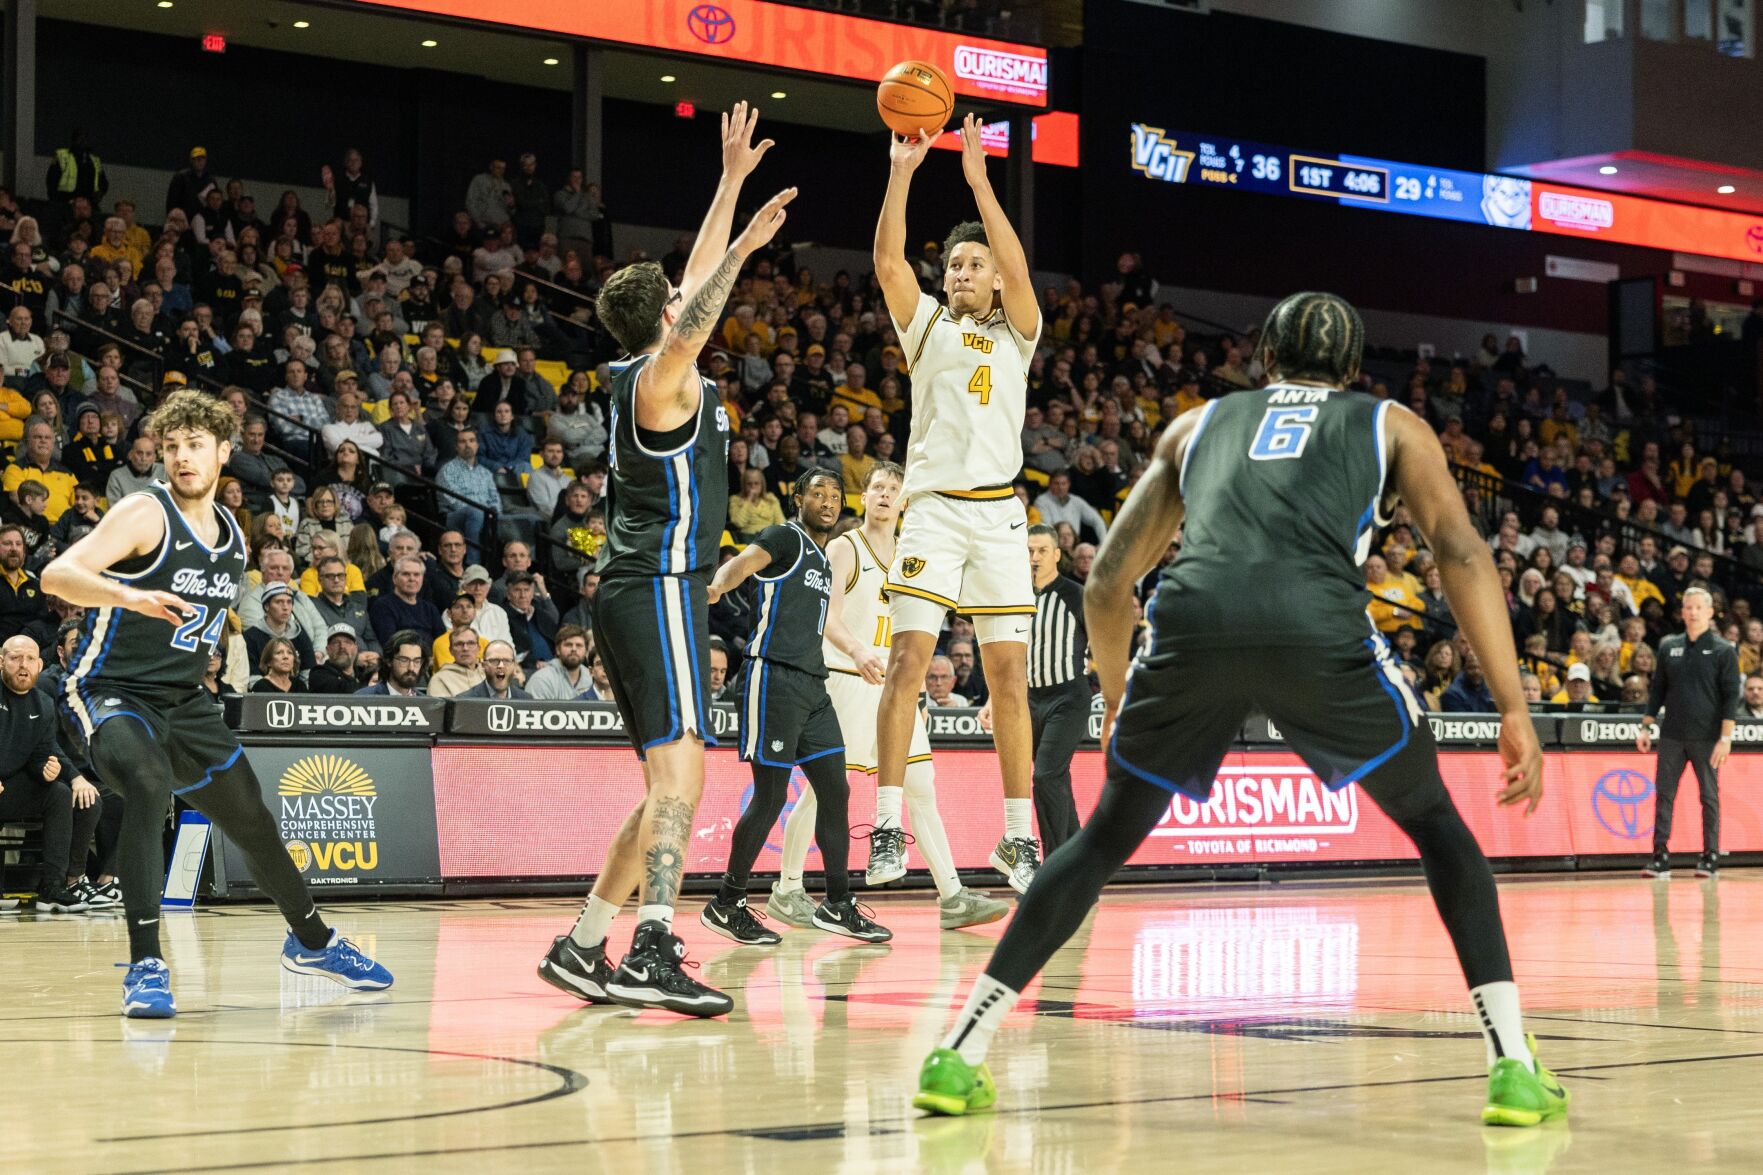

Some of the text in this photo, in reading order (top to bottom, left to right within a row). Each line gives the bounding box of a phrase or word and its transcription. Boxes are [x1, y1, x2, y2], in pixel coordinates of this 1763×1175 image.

[1131, 123, 1194, 183] VCU
[1229, 145, 1240, 159] 4
[1235, 158, 1245, 172] 7
[1252, 154, 1280, 181] 36
[1300, 166, 1380, 193] 1ST 4:06
[1395, 176, 1422, 201] 29
[1427, 174, 1437, 188] 4
[961, 332, 994, 354] VCU
[968, 365, 992, 405] 4
[1267, 389, 1329, 403] ANYA
[1248, 405, 1319, 460] 6
[170, 568, 208, 596] The
[804, 568, 823, 591] The
[170, 602, 228, 655] 24
[873, 616, 892, 647] 11
[298, 705, 430, 726] HONDA
[1445, 722, 1502, 739] HON
[1598, 723, 1661, 740] HOND
[281, 796, 378, 819] MASSEY
[281, 820, 375, 830] COMPREHENSIVE
[281, 830, 376, 839] CANCER CENTER
[310, 841, 378, 870] VCU
[1187, 838, 1318, 854] TOYOTA OF RICHMOND
